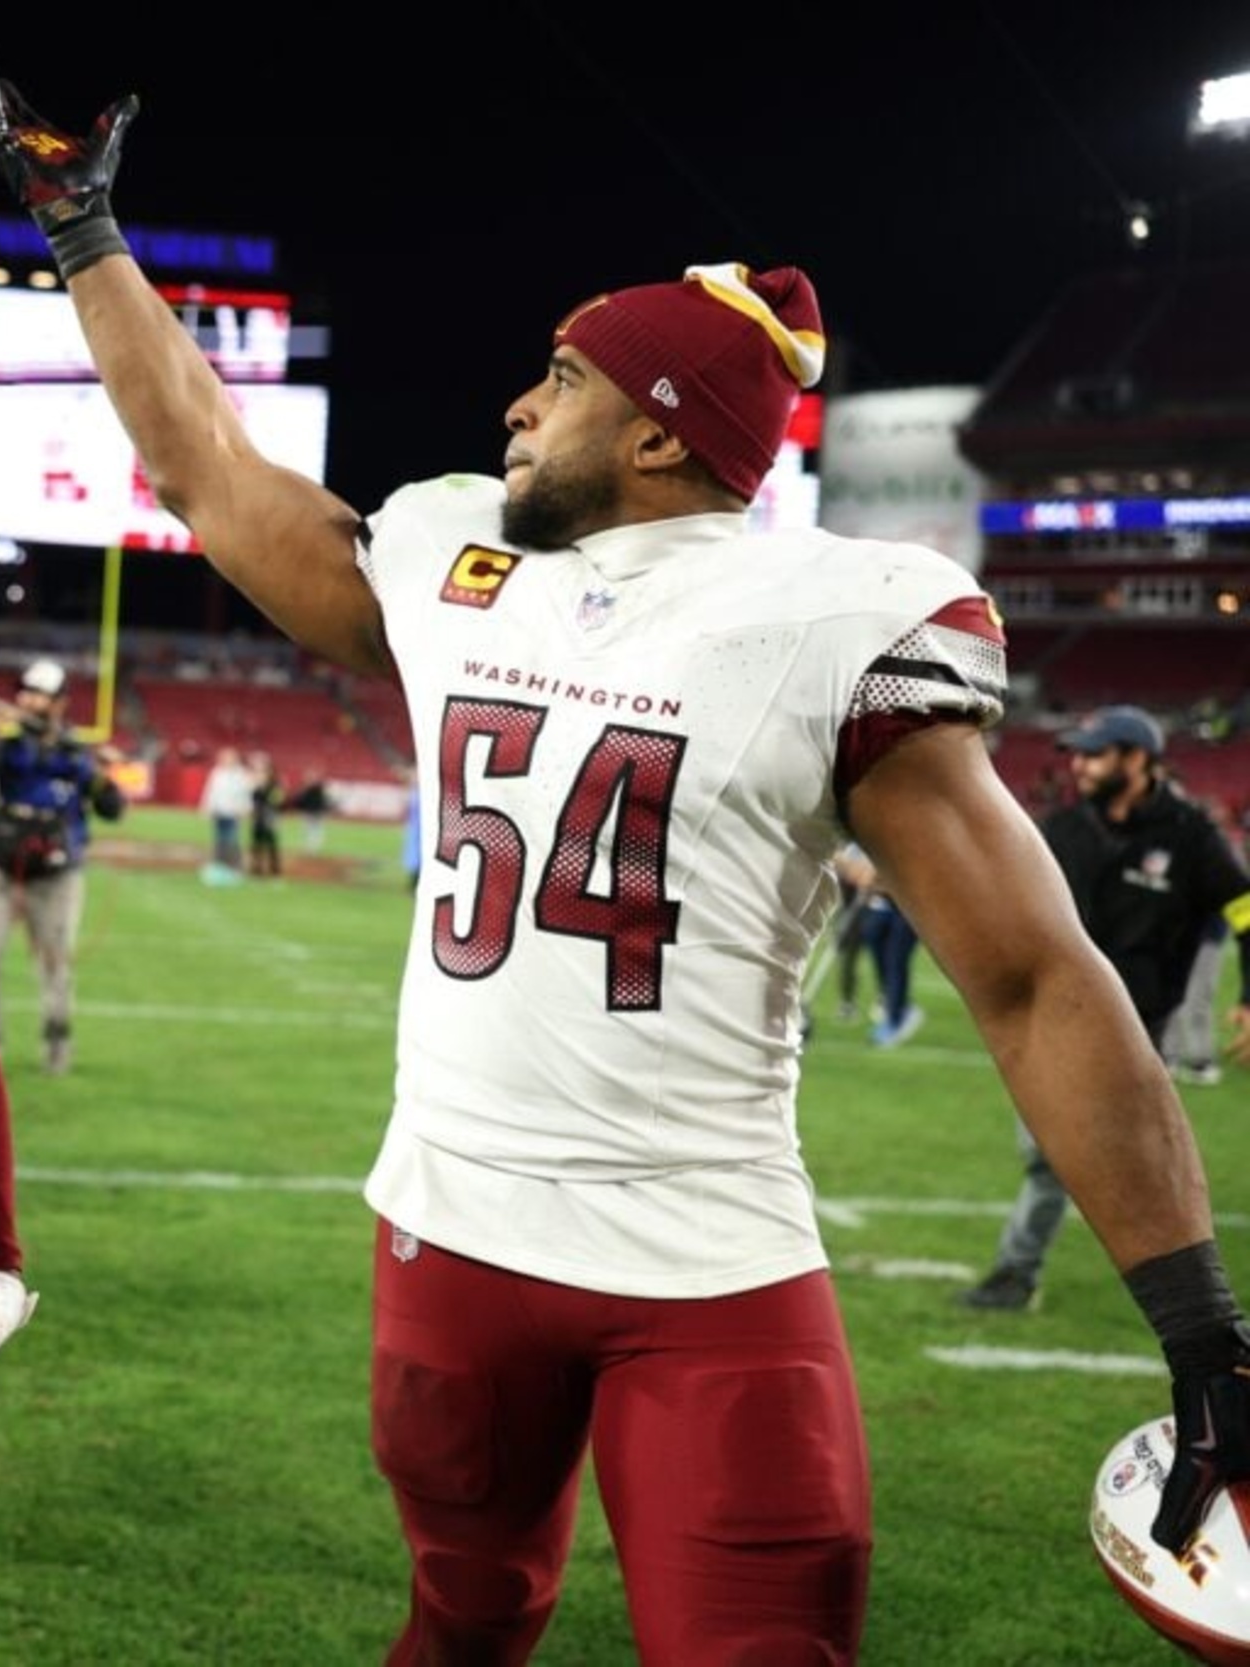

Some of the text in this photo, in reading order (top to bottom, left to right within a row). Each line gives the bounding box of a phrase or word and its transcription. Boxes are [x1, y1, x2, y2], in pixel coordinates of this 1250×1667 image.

[452, 547, 512, 589] C
[462, 658, 683, 717] WASHINGTON
[432, 695, 689, 1012] 54
